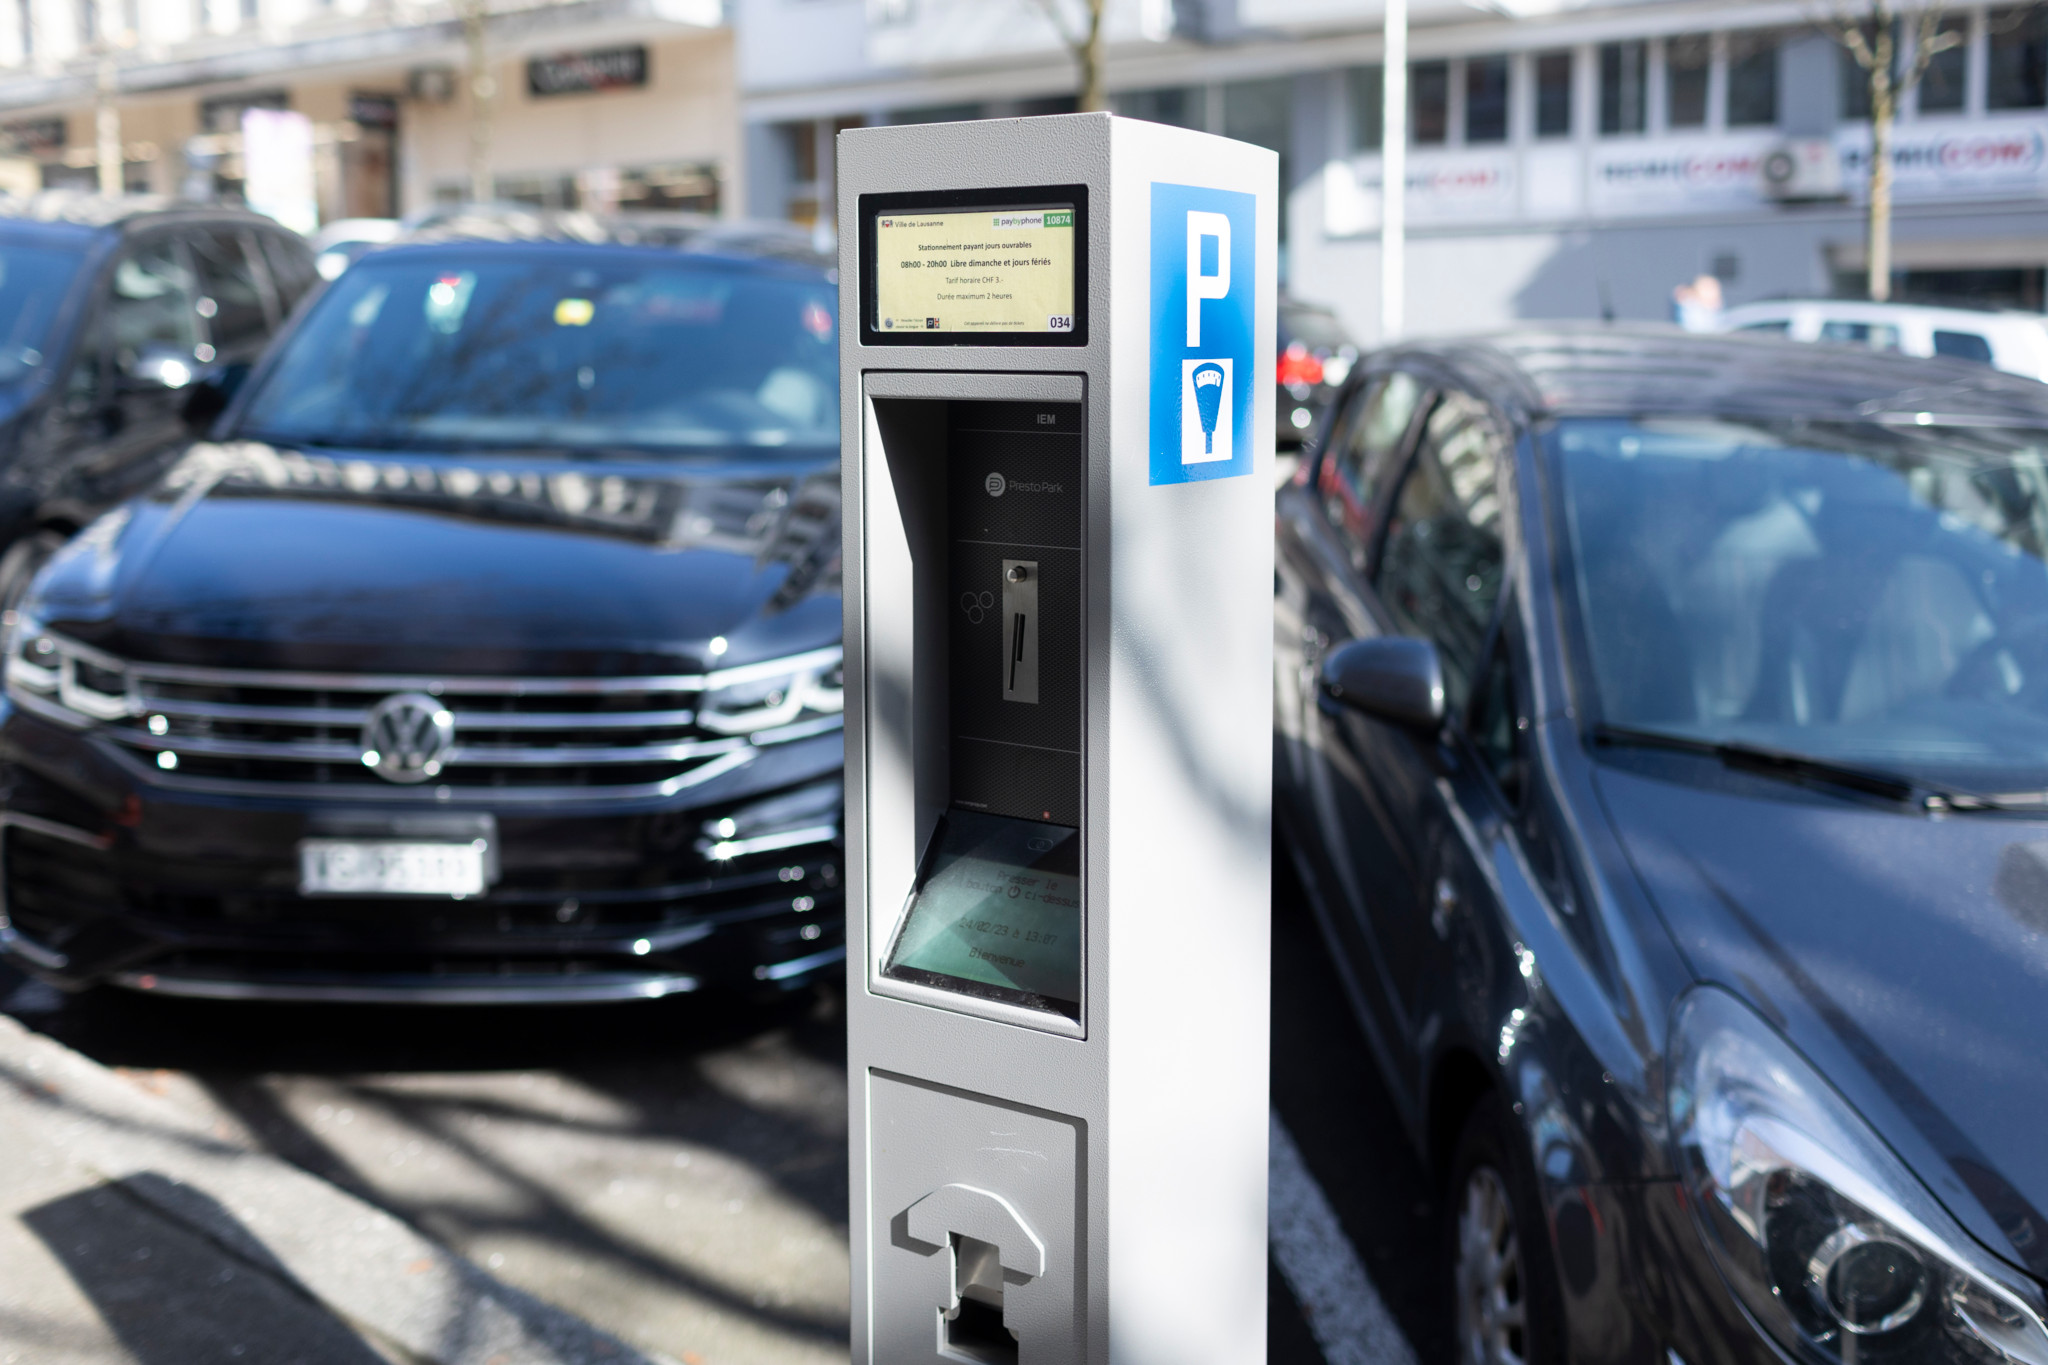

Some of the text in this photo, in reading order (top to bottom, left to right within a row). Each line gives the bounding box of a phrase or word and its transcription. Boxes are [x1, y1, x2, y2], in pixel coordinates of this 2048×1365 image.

[917, 220, 944, 228] Lausanne
[1001, 217, 1042, 226] paybyphone
[1046, 215, 1071, 225] 10874
[1001, 241, 1032, 249] ouvrables
[900, 261, 921, 269] 08h00
[926, 260, 947, 268] 20h00
[950, 260, 967, 268] Libre
[968, 259, 1002, 267] dimanche
[1003, 259, 1011, 267] et
[1012, 259, 1030, 267] jours
[1031, 257, 1051, 266] fériés
[945, 276, 958, 284] Tarif
[959, 276, 981, 284] horaire
[1186, 210, 1231, 348] P
[936, 292, 954, 300] Durée
[955, 292, 985, 300] maximum
[991, 291, 1012, 300] heures
[1050, 316, 1071, 329] 034
[1037, 414, 1056, 425] IEM
[969, 946, 1026, 968] Bienvenue
